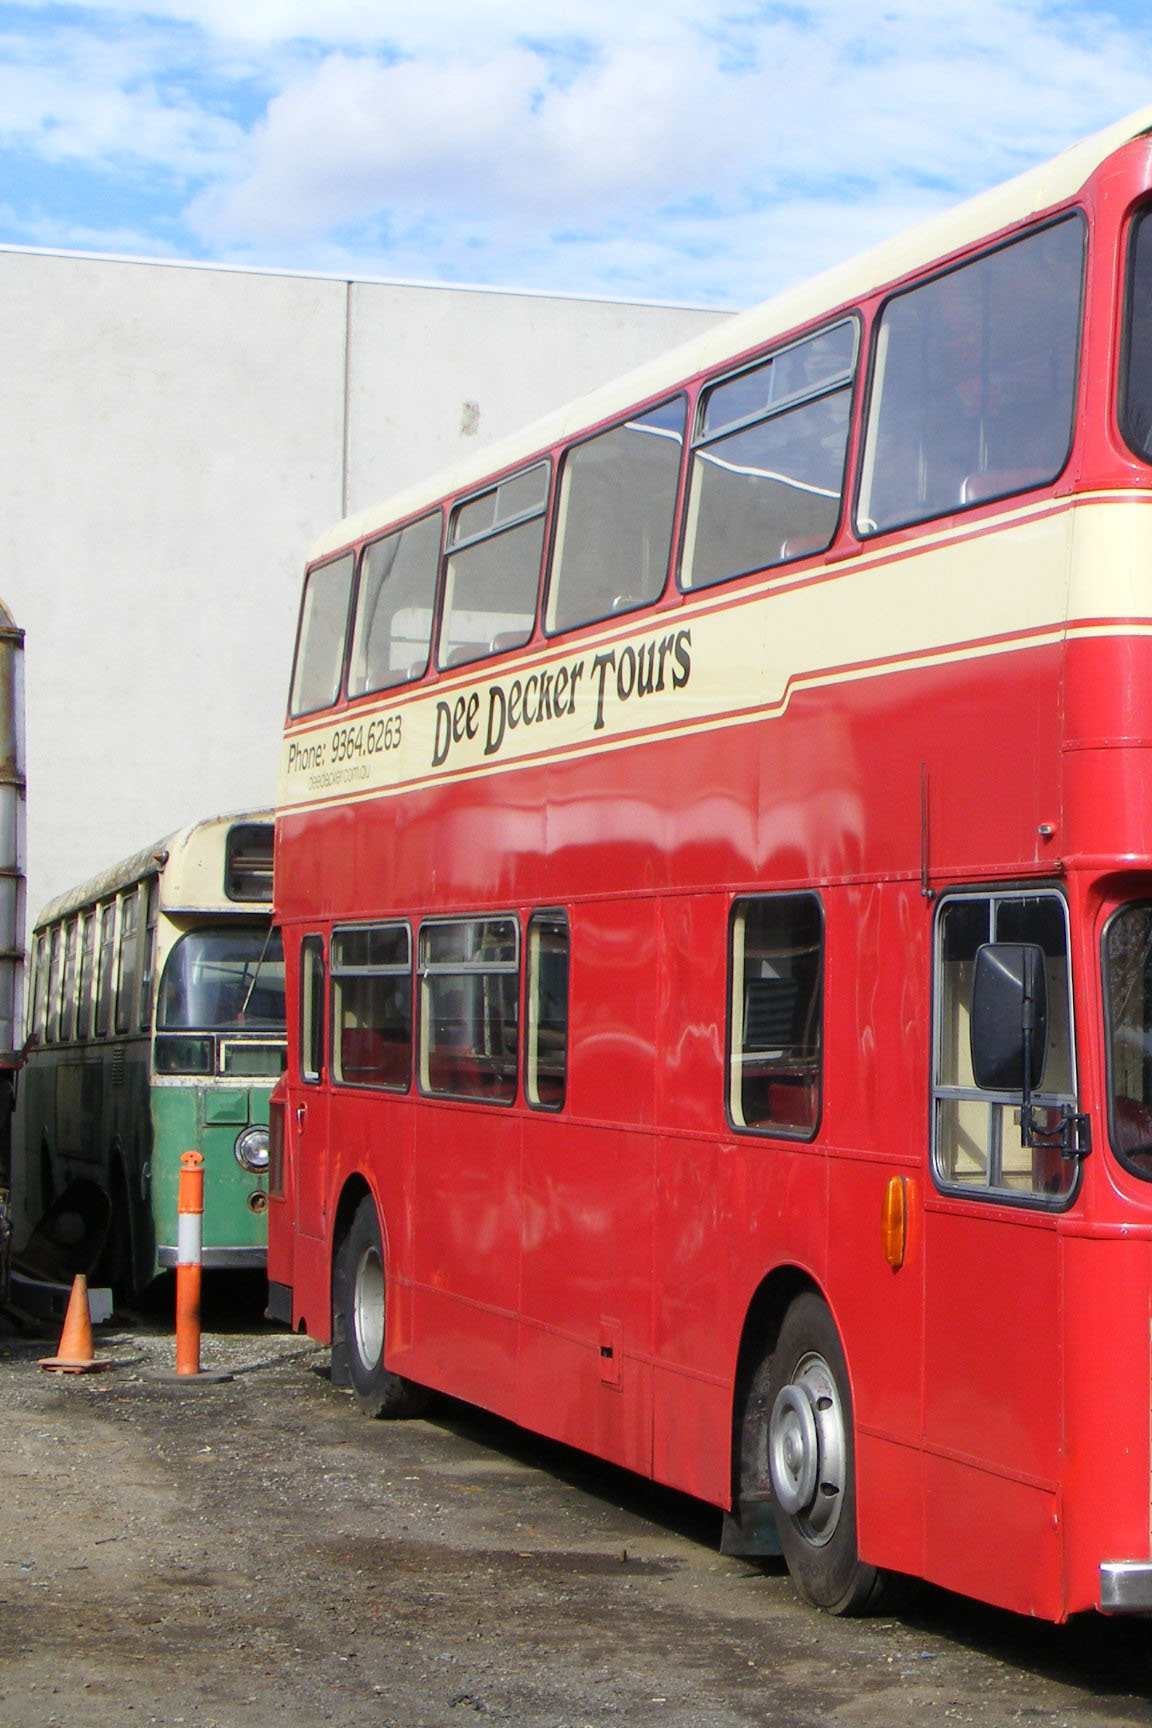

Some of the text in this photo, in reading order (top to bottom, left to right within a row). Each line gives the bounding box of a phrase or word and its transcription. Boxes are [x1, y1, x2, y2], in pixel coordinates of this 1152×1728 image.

[287, 714, 403, 775] Phone: 9364.6263
[431, 628, 692, 768] Dee Decker Tours
